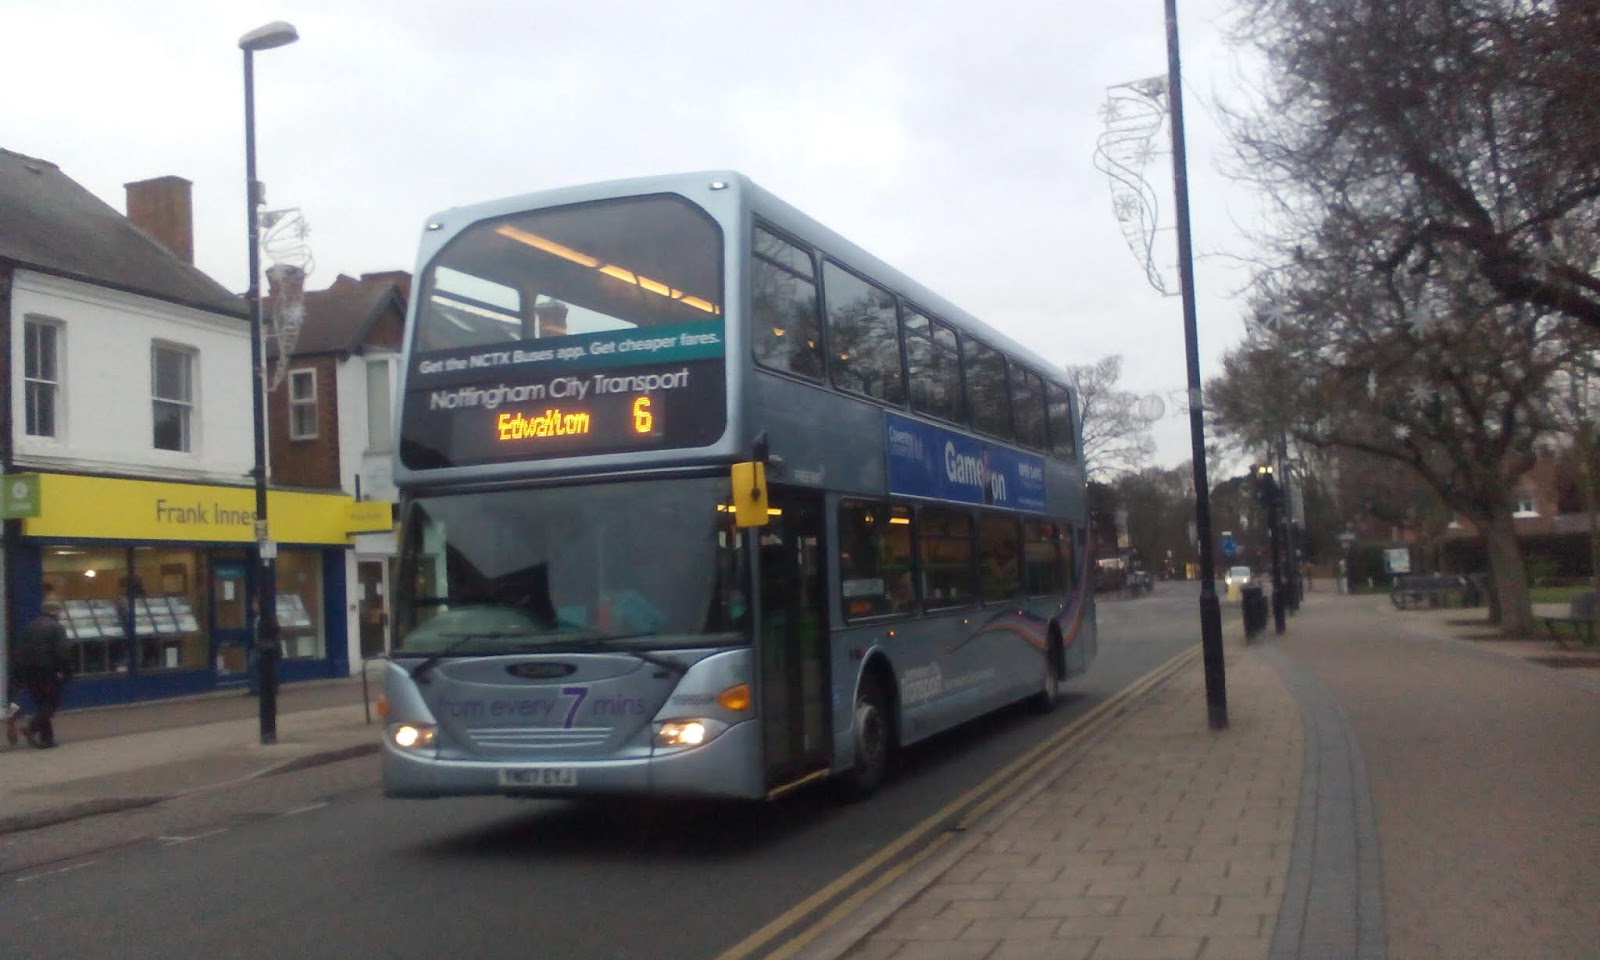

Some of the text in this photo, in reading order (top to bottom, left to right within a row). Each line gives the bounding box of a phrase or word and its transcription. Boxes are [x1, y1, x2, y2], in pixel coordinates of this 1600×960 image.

[419, 332, 720, 374] Get the NCTX Buses app. Get cheaper fares.
[430, 367, 689, 410] Nottingham City Transport
[498, 396, 652, 440] Edwalton 6
[944, 440, 984, 487] Game
[991, 470, 1007, 501] on
[157, 499, 208, 525] Frank
[488, 699, 556, 720] every
[562, 687, 589, 729] 7
[592, 694, 644, 716] mins
